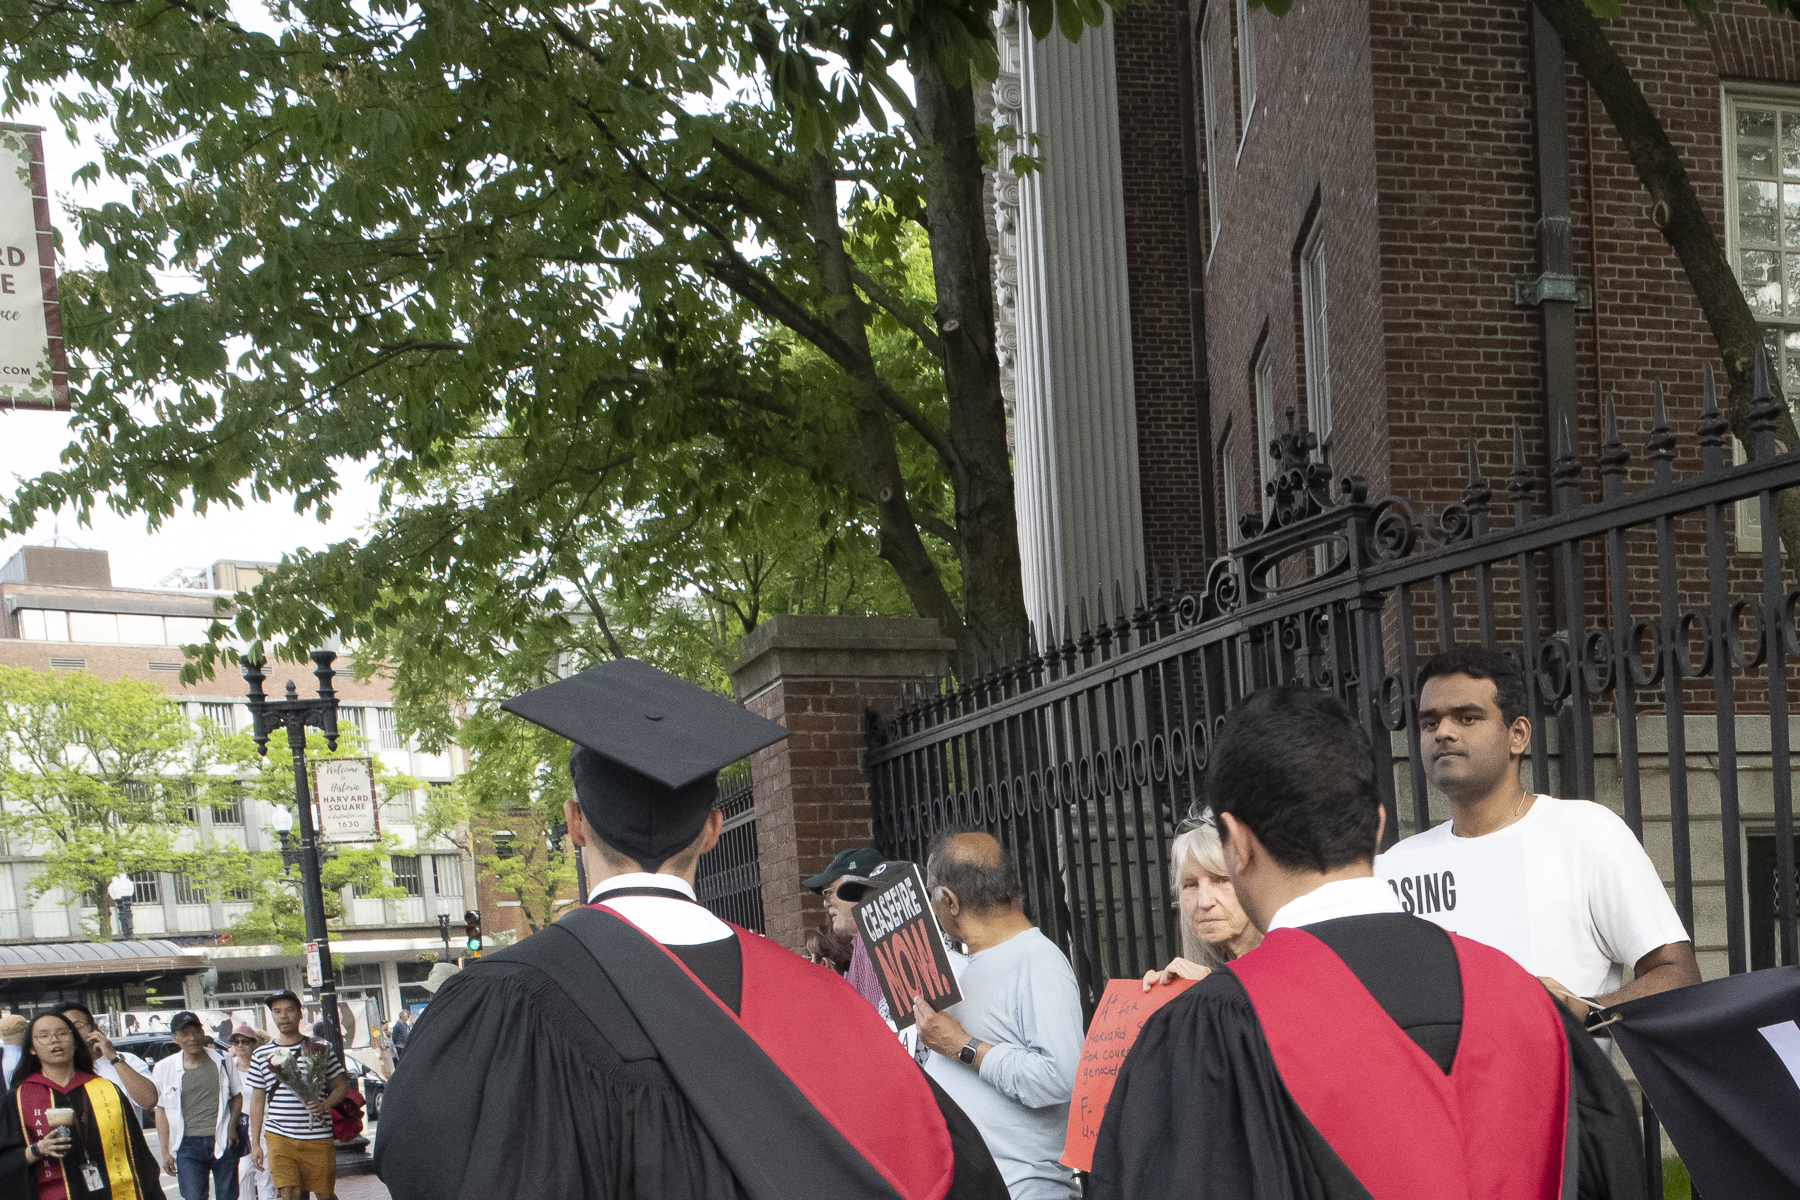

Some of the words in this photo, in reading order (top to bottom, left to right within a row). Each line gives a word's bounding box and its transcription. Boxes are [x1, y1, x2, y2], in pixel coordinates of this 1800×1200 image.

[326, 763, 358, 774] Welcome
[323, 794, 369, 803] HARVARD
[328, 803, 366, 812] SQUARE
[861, 876, 923, 943] CEASEFIRE
[875, 917, 951, 1018] NOW.
[34, 1108, 52, 1178] HARRD
